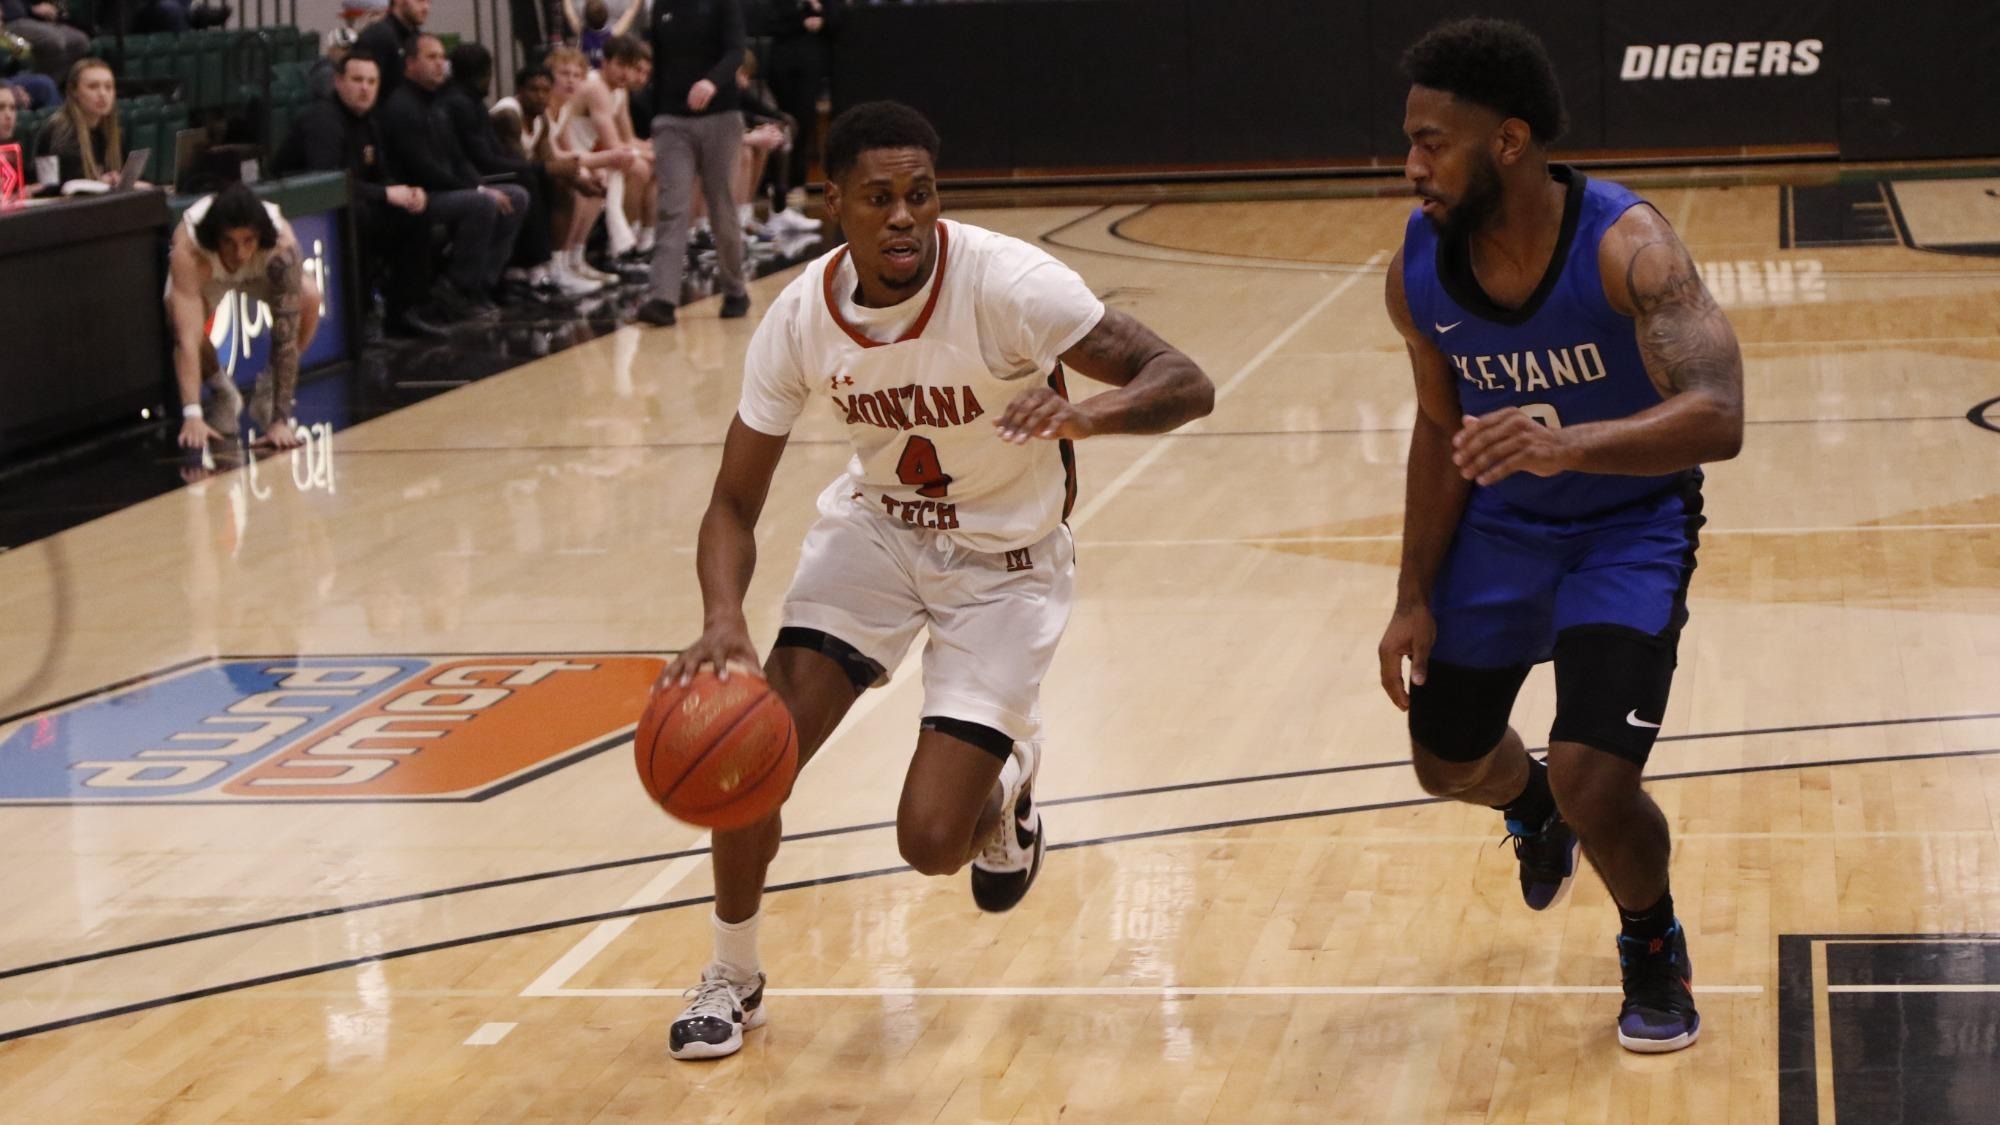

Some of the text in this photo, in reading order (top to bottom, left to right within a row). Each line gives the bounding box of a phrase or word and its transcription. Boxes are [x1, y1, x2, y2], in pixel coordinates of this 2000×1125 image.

[1620, 38, 1823, 81] DIGGERS
[832, 384, 985, 431] MONTANA
[895, 434, 953, 498] 4
[881, 494, 960, 530] TECH
